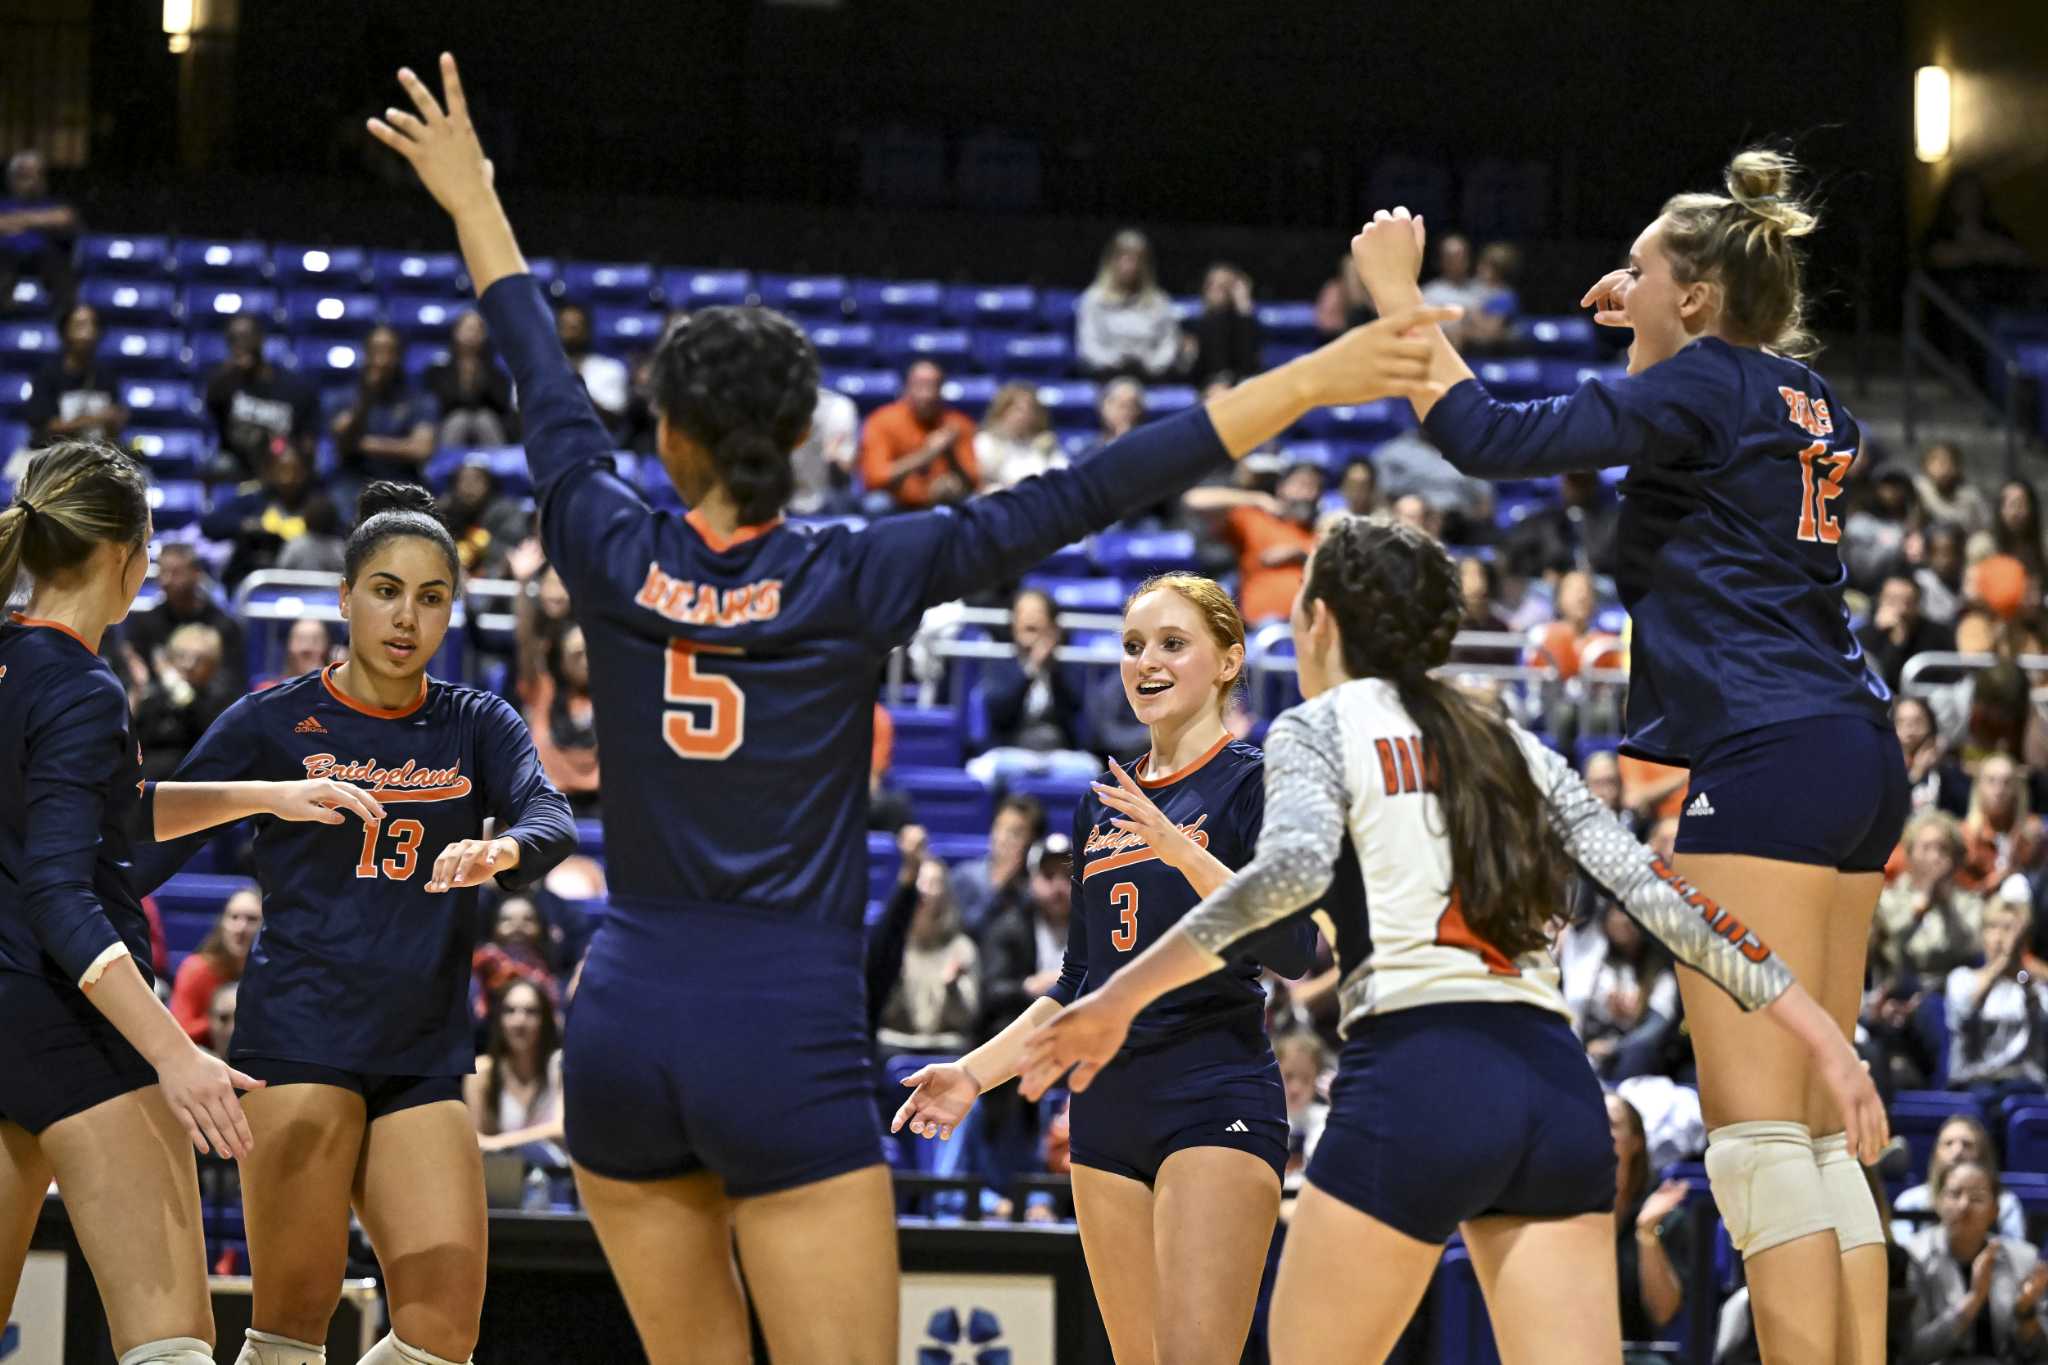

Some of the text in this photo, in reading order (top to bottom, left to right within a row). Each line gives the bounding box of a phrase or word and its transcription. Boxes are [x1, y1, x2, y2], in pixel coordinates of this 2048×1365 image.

[1797, 440, 1853, 544] 12
[634, 561, 783, 628] BEARS
[662, 636, 745, 760] 5
[303, 753, 462, 792] Bridgeland
[356, 818, 425, 880] 13
[1110, 881, 1139, 952] 3
